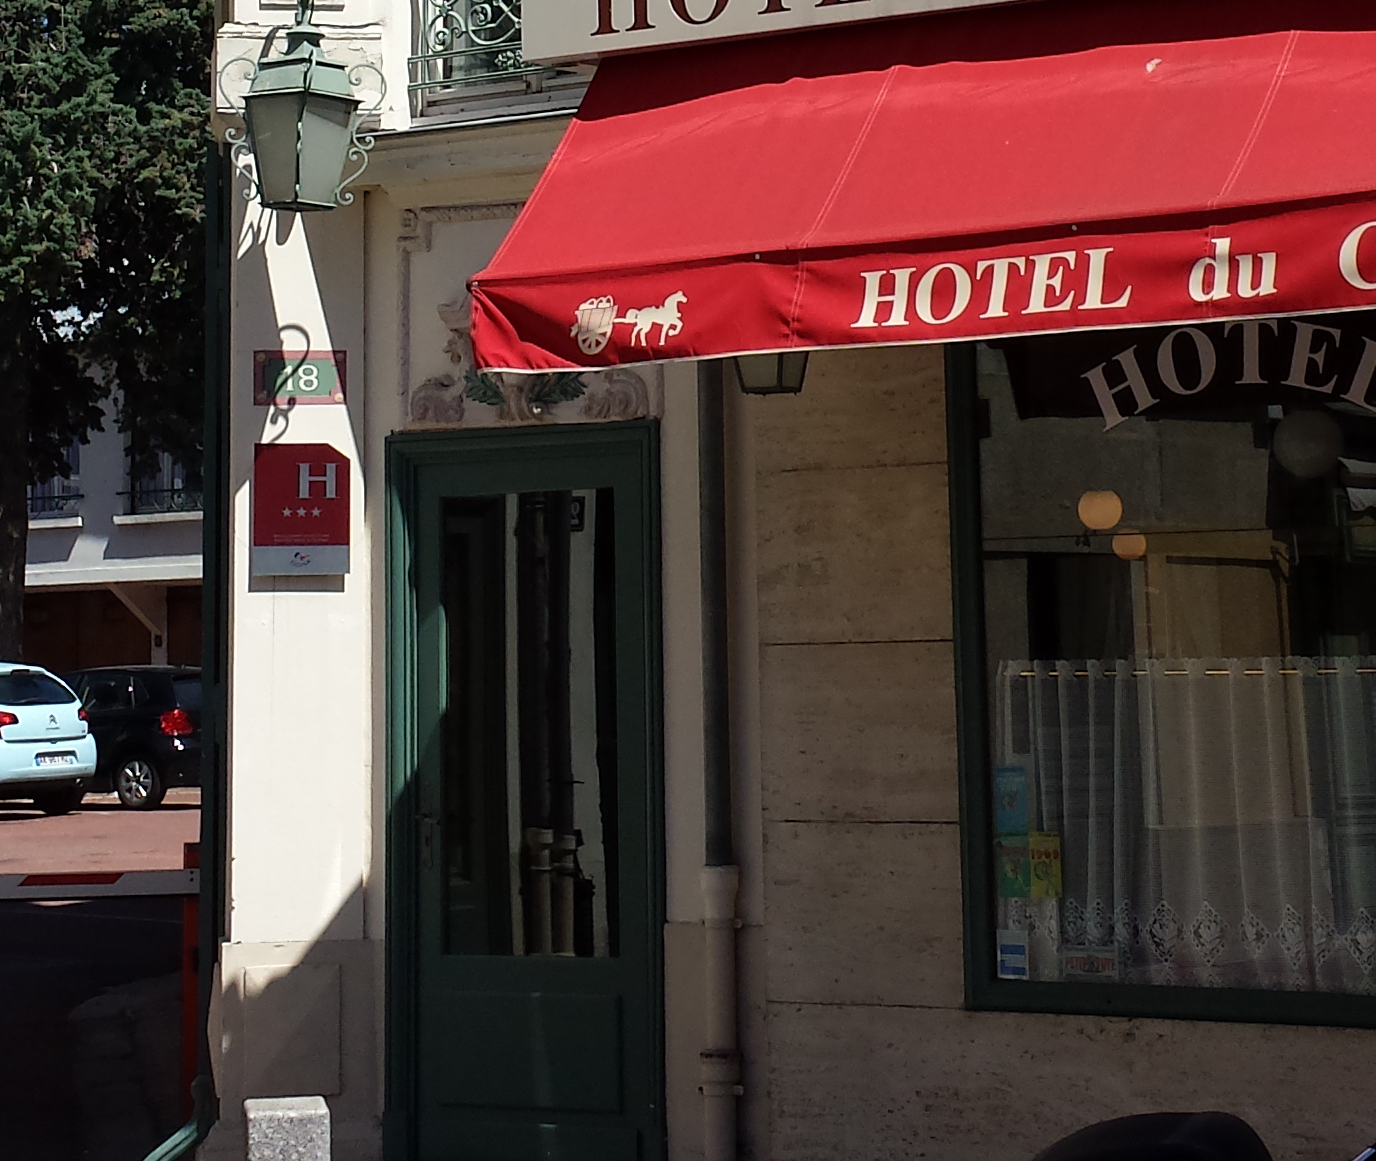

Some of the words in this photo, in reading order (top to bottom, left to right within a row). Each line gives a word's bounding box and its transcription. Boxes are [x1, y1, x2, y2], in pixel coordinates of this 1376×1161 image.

[850, 247, 1133, 329] HOTEL
[1188, 237, 1278, 303] du
[281, 364, 319, 392] 18
[295, 462, 340, 499] H
